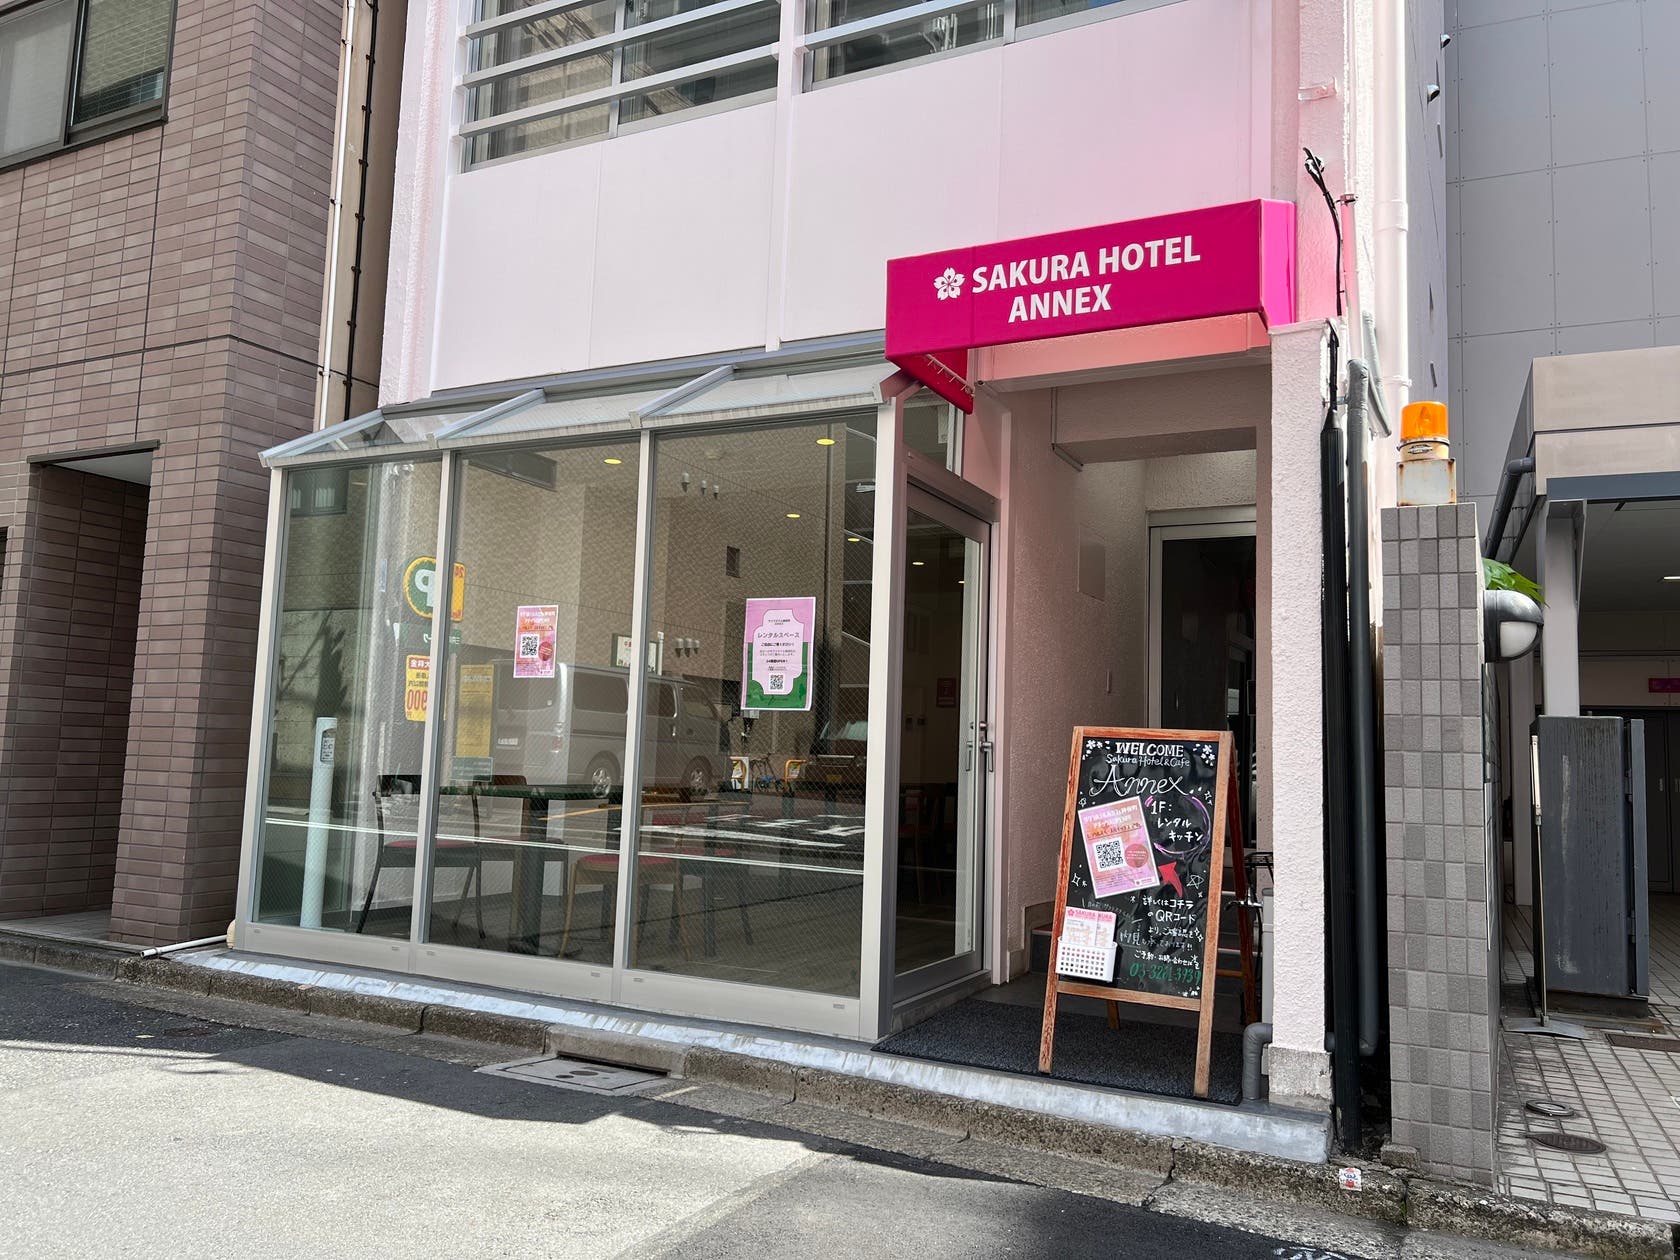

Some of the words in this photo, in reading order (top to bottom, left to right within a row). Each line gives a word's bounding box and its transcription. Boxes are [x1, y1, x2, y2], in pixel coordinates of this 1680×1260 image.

[972, 251, 1090, 294] SAKURA
[1099, 235, 1201, 275] HOTEL
[1008, 283, 1112, 323] ANNEX
[1115, 742, 1184, 757] WELCOME
[1106, 754, 1138, 765] Sakura
[1089, 765, 1188, 797] Annex
[1157, 816, 1192, 829] レンタル
[1169, 829, 1204, 843] キッチン
[1142, 895, 1194, 910] 詳しくはコチラ
[1147, 909, 1197, 925] のQRコード
